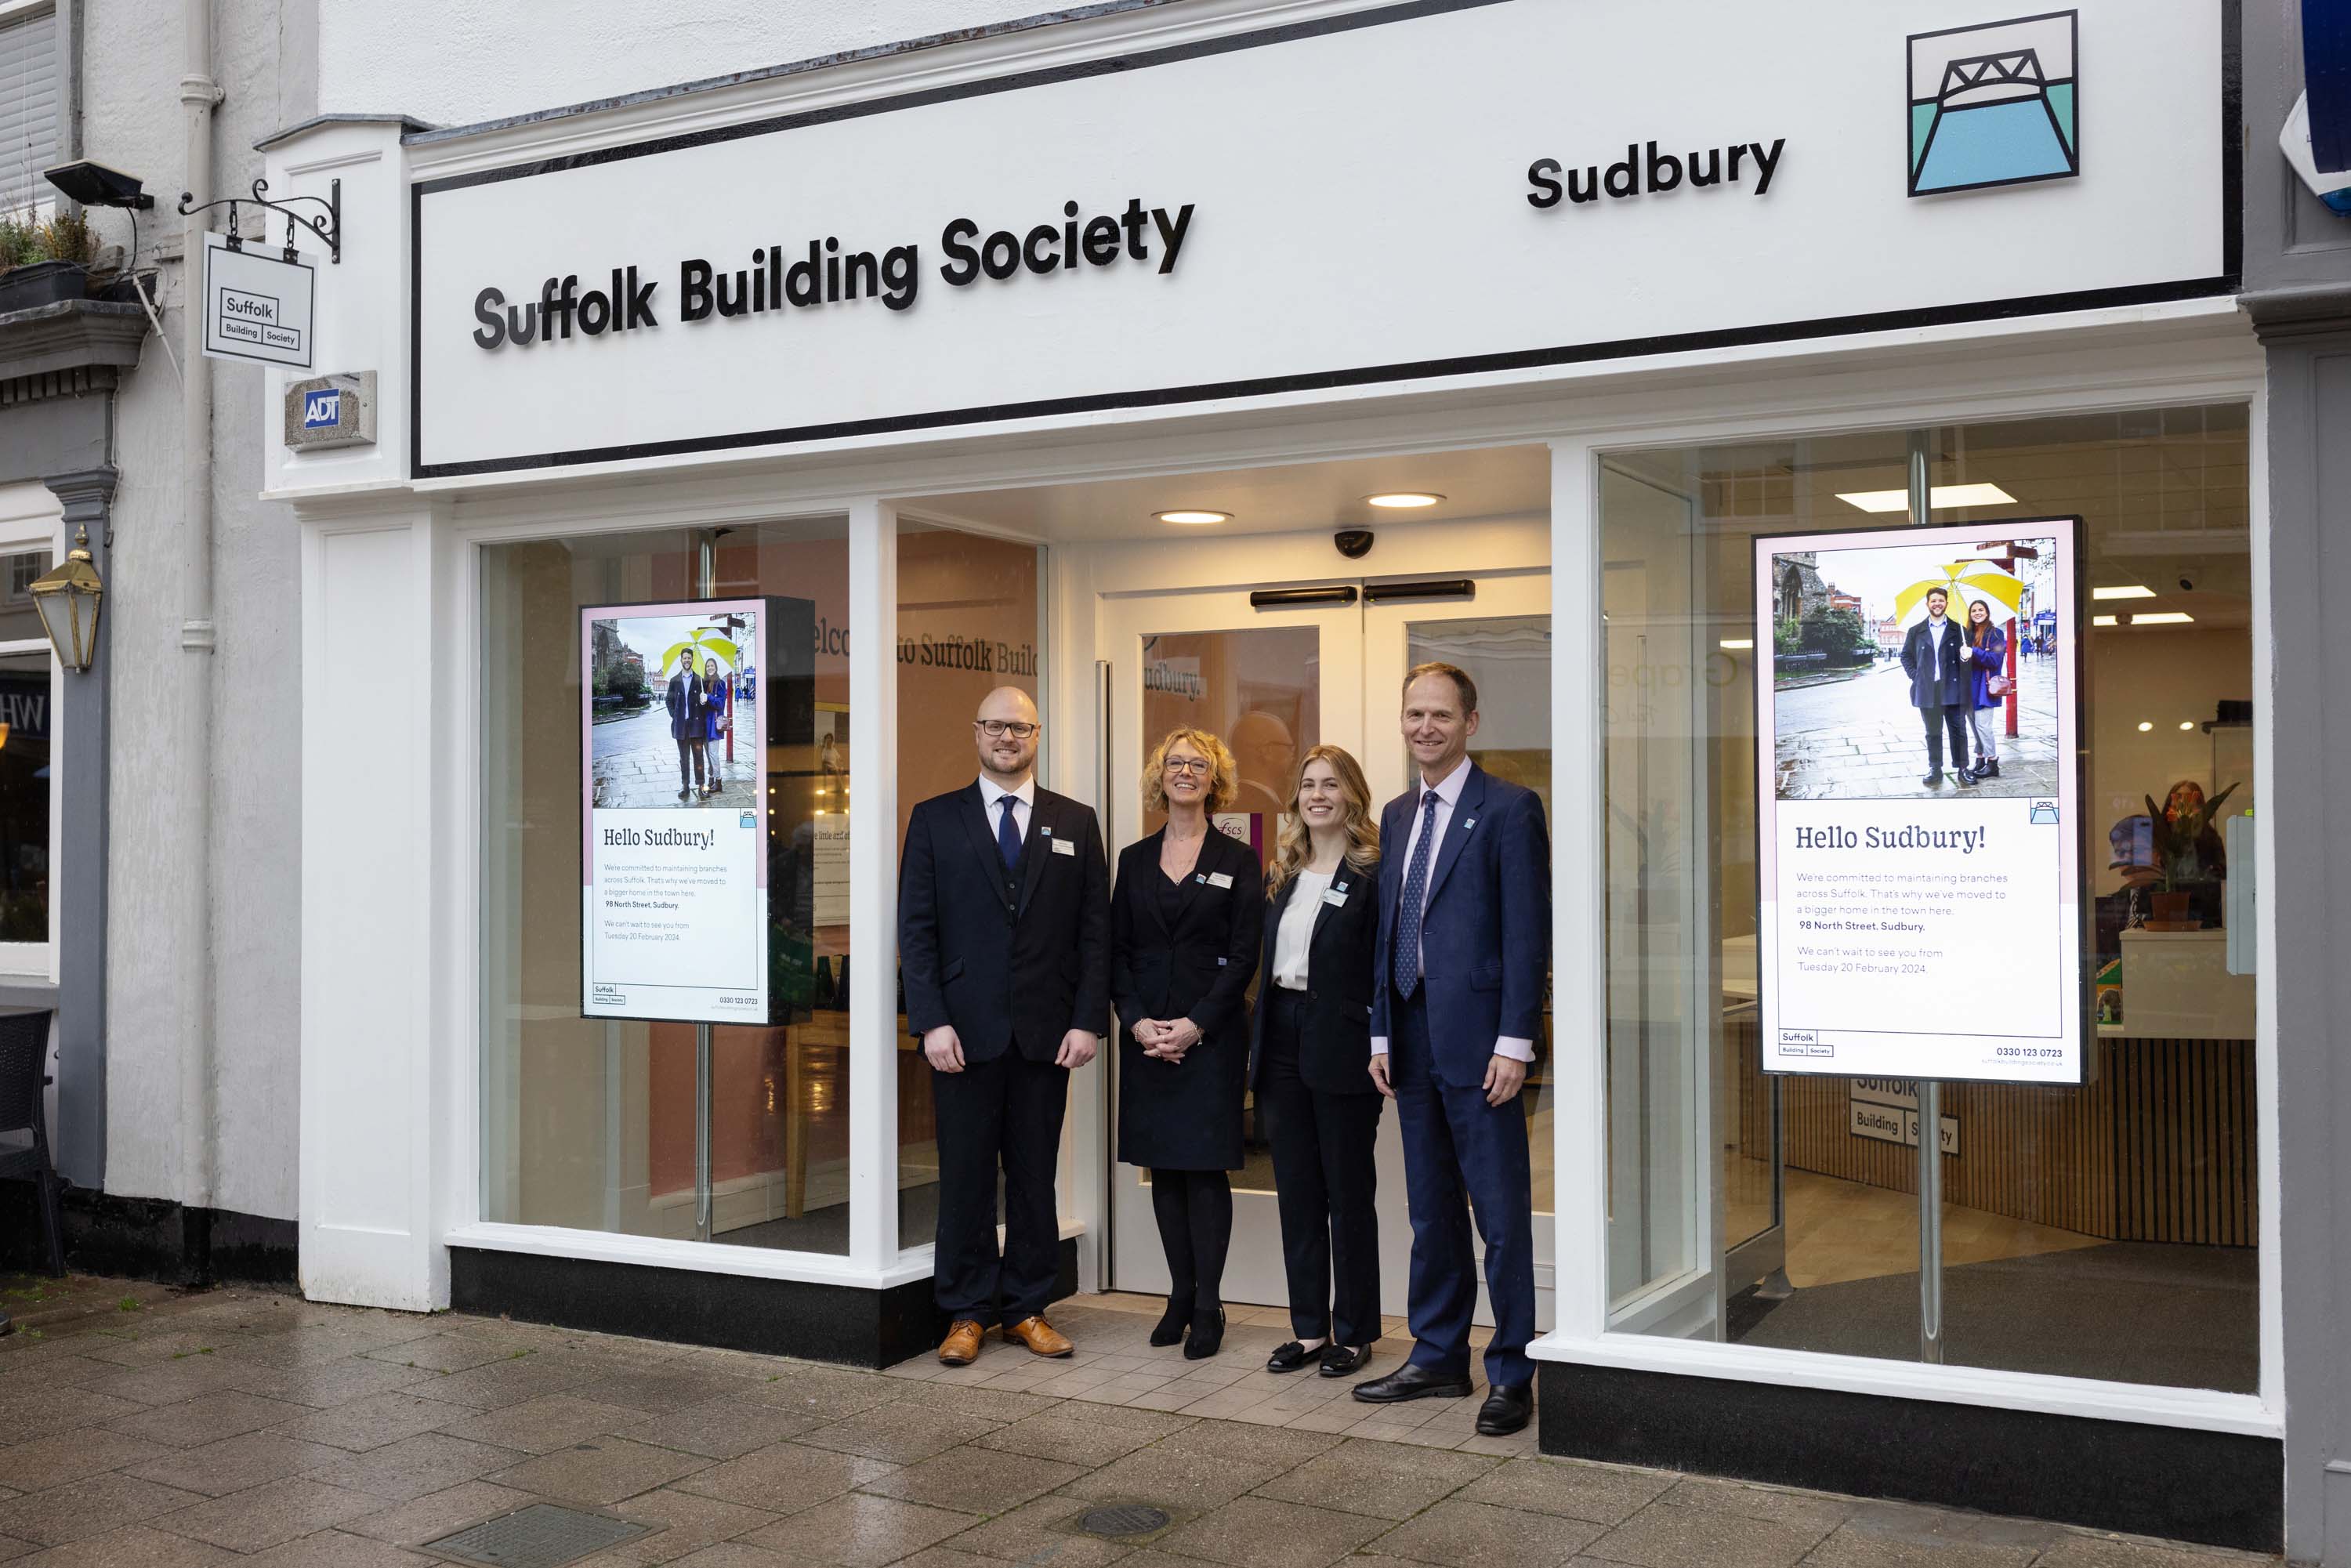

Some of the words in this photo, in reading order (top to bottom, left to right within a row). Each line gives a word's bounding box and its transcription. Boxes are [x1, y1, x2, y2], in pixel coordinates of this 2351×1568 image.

[1527, 138, 1786, 208] Sudbury
[473, 265, 658, 349] Suffolk
[681, 236, 918, 322] Building
[940, 198, 1194, 285] Society
[226, 297, 273, 318] Suffolk
[226, 324, 258, 339] Building
[266, 331, 295, 345] Society
[306, 396, 339, 422] ADT
[921, 632, 992, 672] Suffolk
[1144, 661, 1200, 701] udbury.
[603, 827, 640, 846] Hello
[644, 827, 714, 851] Sudbury!
[1795, 825, 1857, 849] Hello
[1865, 824, 1985, 854] Sudbury!
[662, 864, 697, 875] maintaining
[665, 878, 678, 887] why
[1826, 873, 1882, 882] committed
[1884, 874, 1895, 882] to
[1897, 873, 1957, 885] maintaining
[1960, 874, 2009, 882] branches
[608, 888, 628, 897] bigger
[1901, 890, 1922, 901] why
[1957, 890, 1992, 899] moved
[1994, 891, 2006, 900] to
[653, 901, 679, 911] Sudbury.
[1805, 905, 1837, 916] bigger
[1839, 906, 1868, 914] home
[1871, 906, 1879, 914] in
[1882, 906, 1898, 914] the
[1929, 907, 1954, 915] here.
[662, 922, 674, 931] you
[1799, 921, 1812, 929] 98
[1814, 921, 1843, 930] North
[1881, 922, 1925, 933] Sudbury.
[604, 932, 629, 941] Tuesday
[638, 932, 663, 943] February
[1797, 946, 1814, 955] We
[1817, 947, 1840, 956] can't
[1842, 947, 1862, 957] wait
[1865, 948, 1875, 957] to
[1898, 950, 1917, 959] you
[1919, 948, 1943, 958] from
[1797, 961, 1838, 974] Tuesday
[1841, 963, 1853, 972] 20
[1856, 963, 1899, 976] February
[1782, 1033, 1813, 1041] Suffolk
[2040, 1049, 2063, 1058] 0723
[1857, 1111, 1898, 1135] Building
